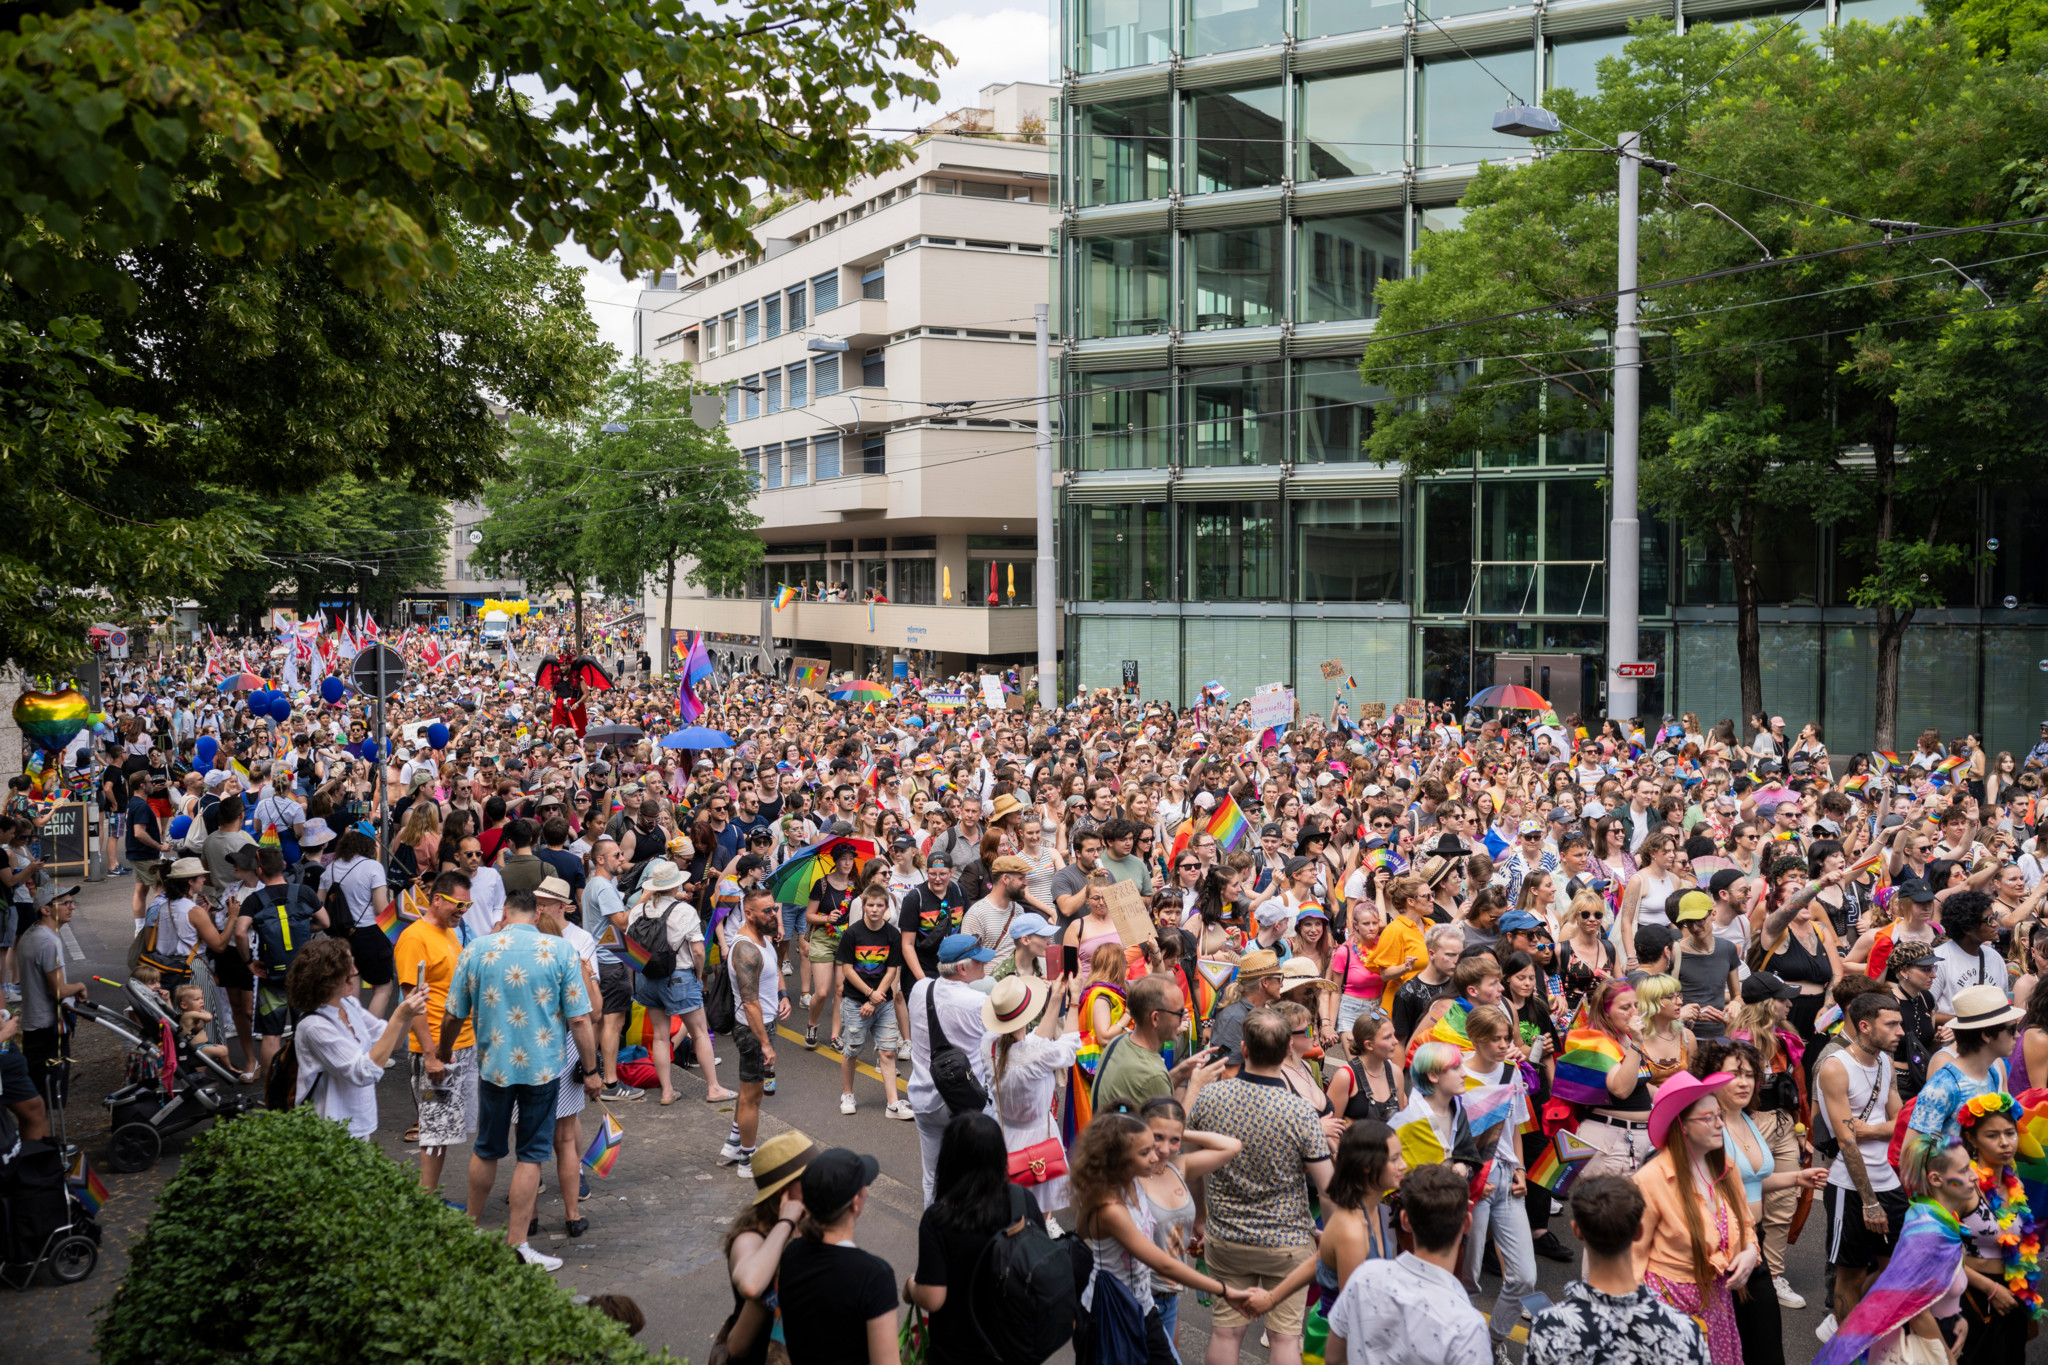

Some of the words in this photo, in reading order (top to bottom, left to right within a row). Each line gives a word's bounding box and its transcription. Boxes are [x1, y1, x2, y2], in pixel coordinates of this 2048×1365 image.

[928, 695, 943, 704] NO
[944, 696, 967, 705] WAR
[44, 812, 76, 824] OIN
[44, 824, 74, 836] COIN
[1957, 968, 1977, 987] HUGO
